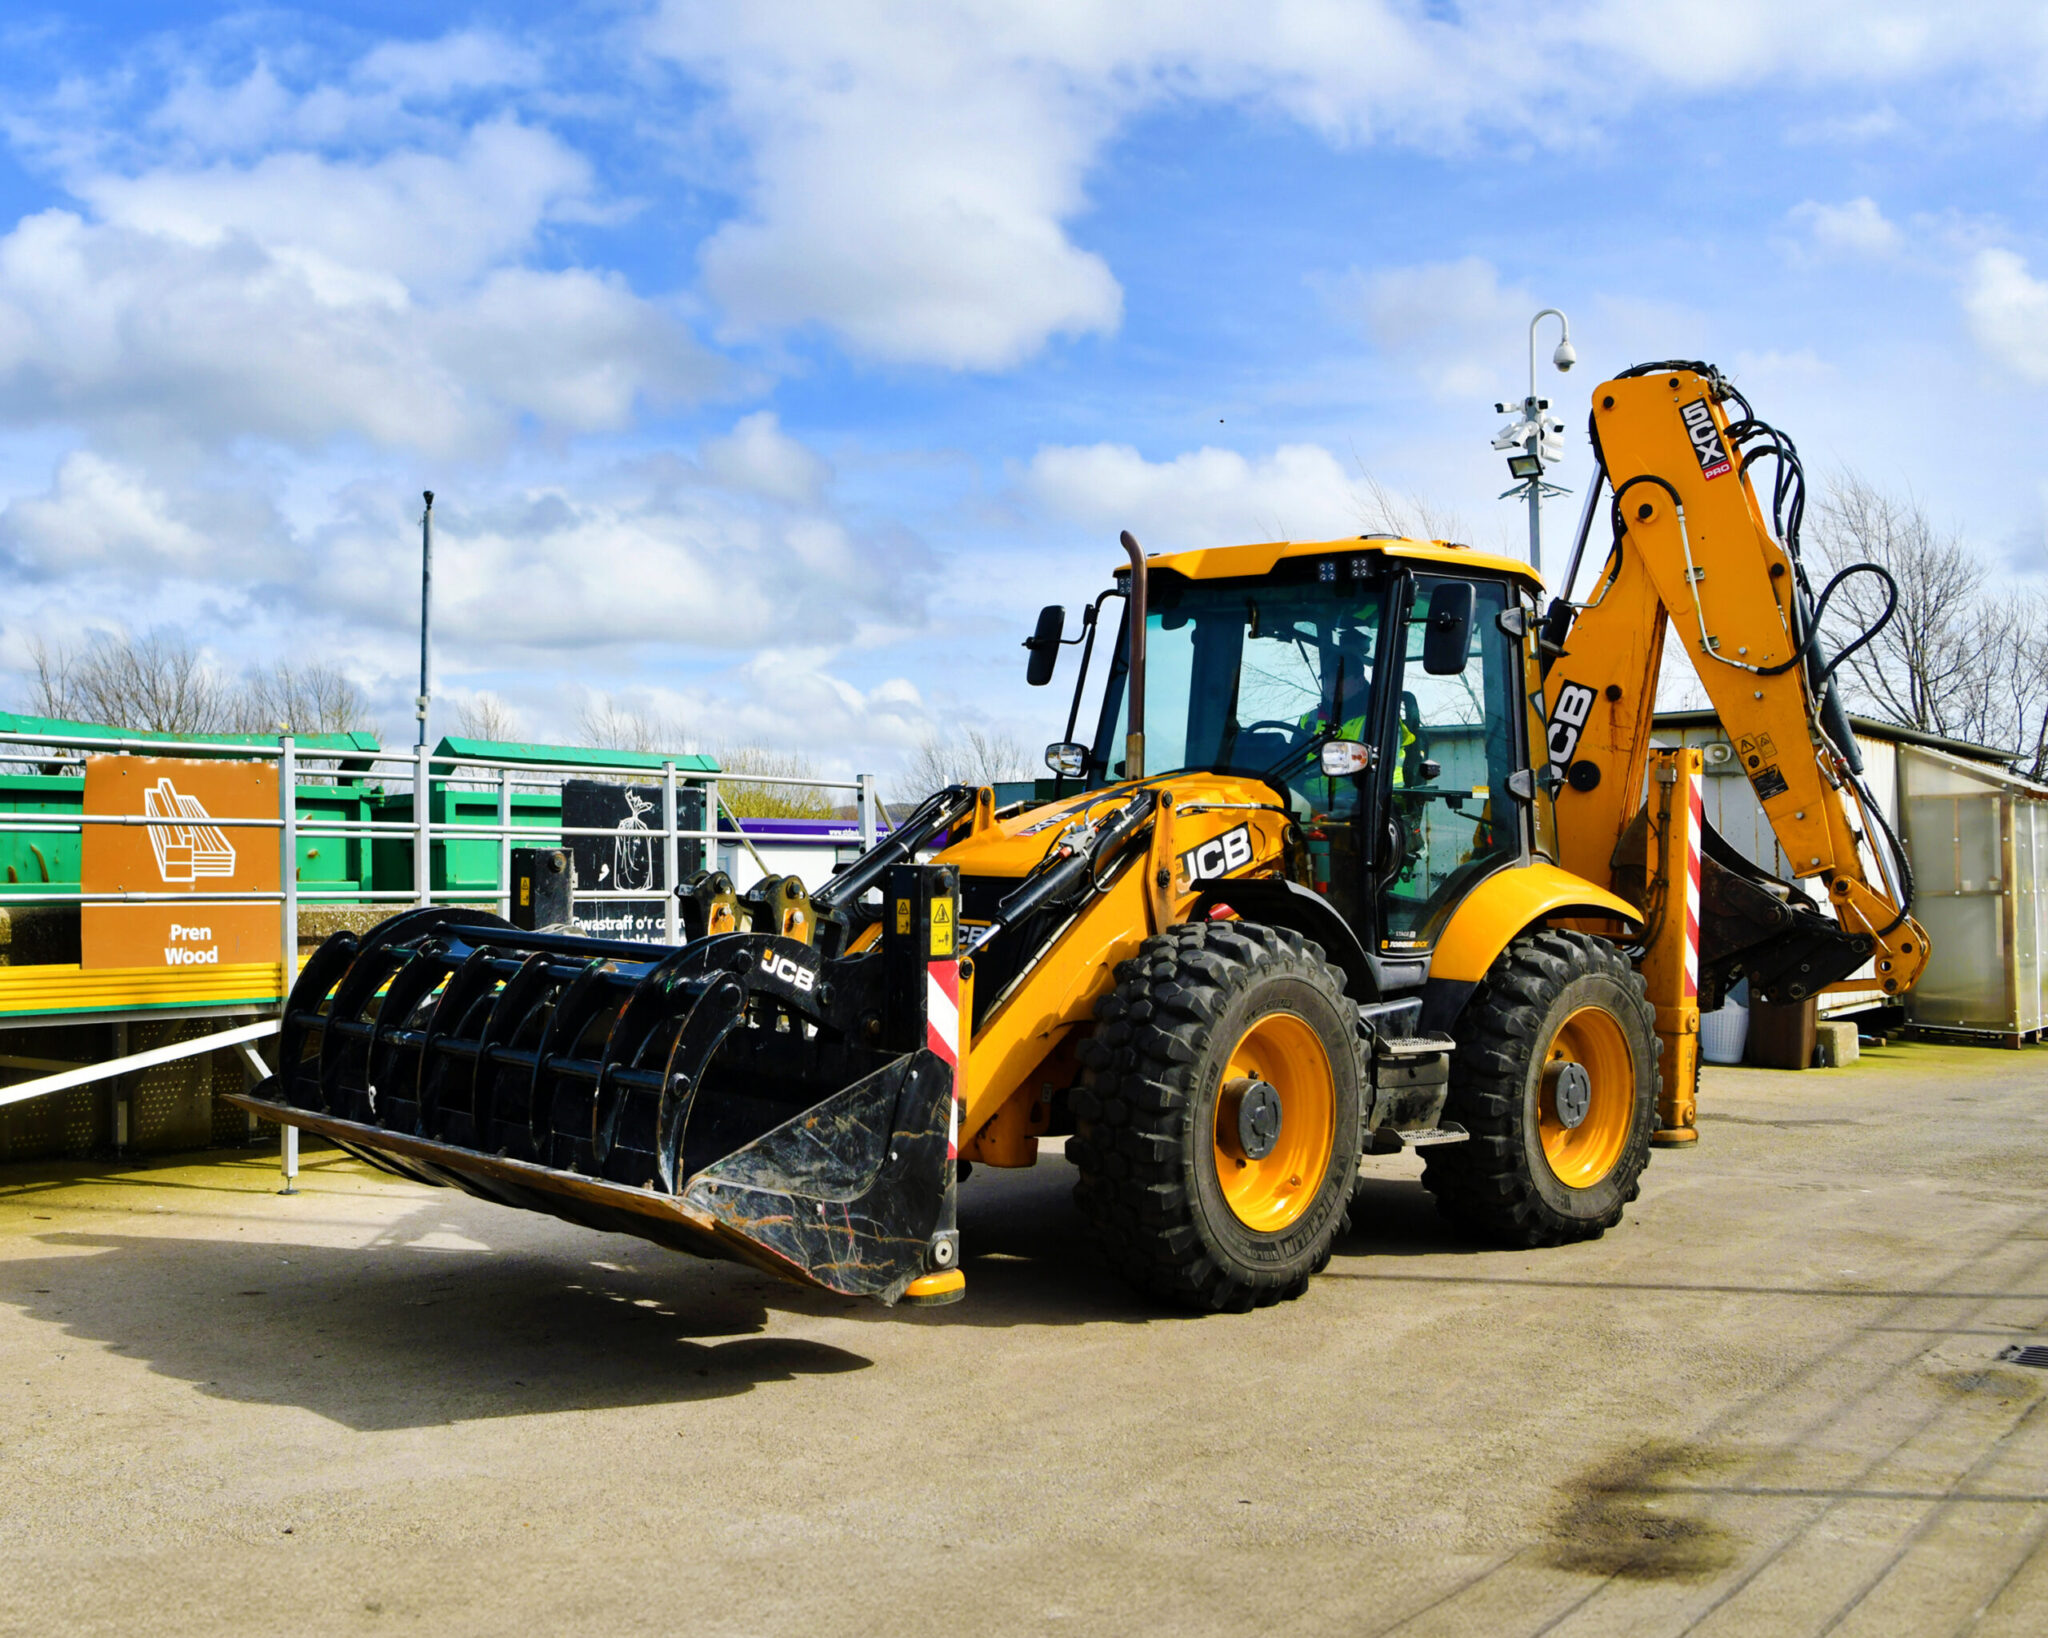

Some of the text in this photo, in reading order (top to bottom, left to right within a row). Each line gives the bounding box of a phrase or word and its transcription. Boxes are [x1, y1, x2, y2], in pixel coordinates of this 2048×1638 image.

[1682, 401, 1725, 465] 5CX
[1705, 463, 1731, 479] PRO
[1176, 827, 1251, 894] JCB
[170, 923, 212, 941] Pren
[571, 915, 634, 931] Gwastraff
[164, 945, 219, 966] Wood
[761, 950, 815, 992] JCB
